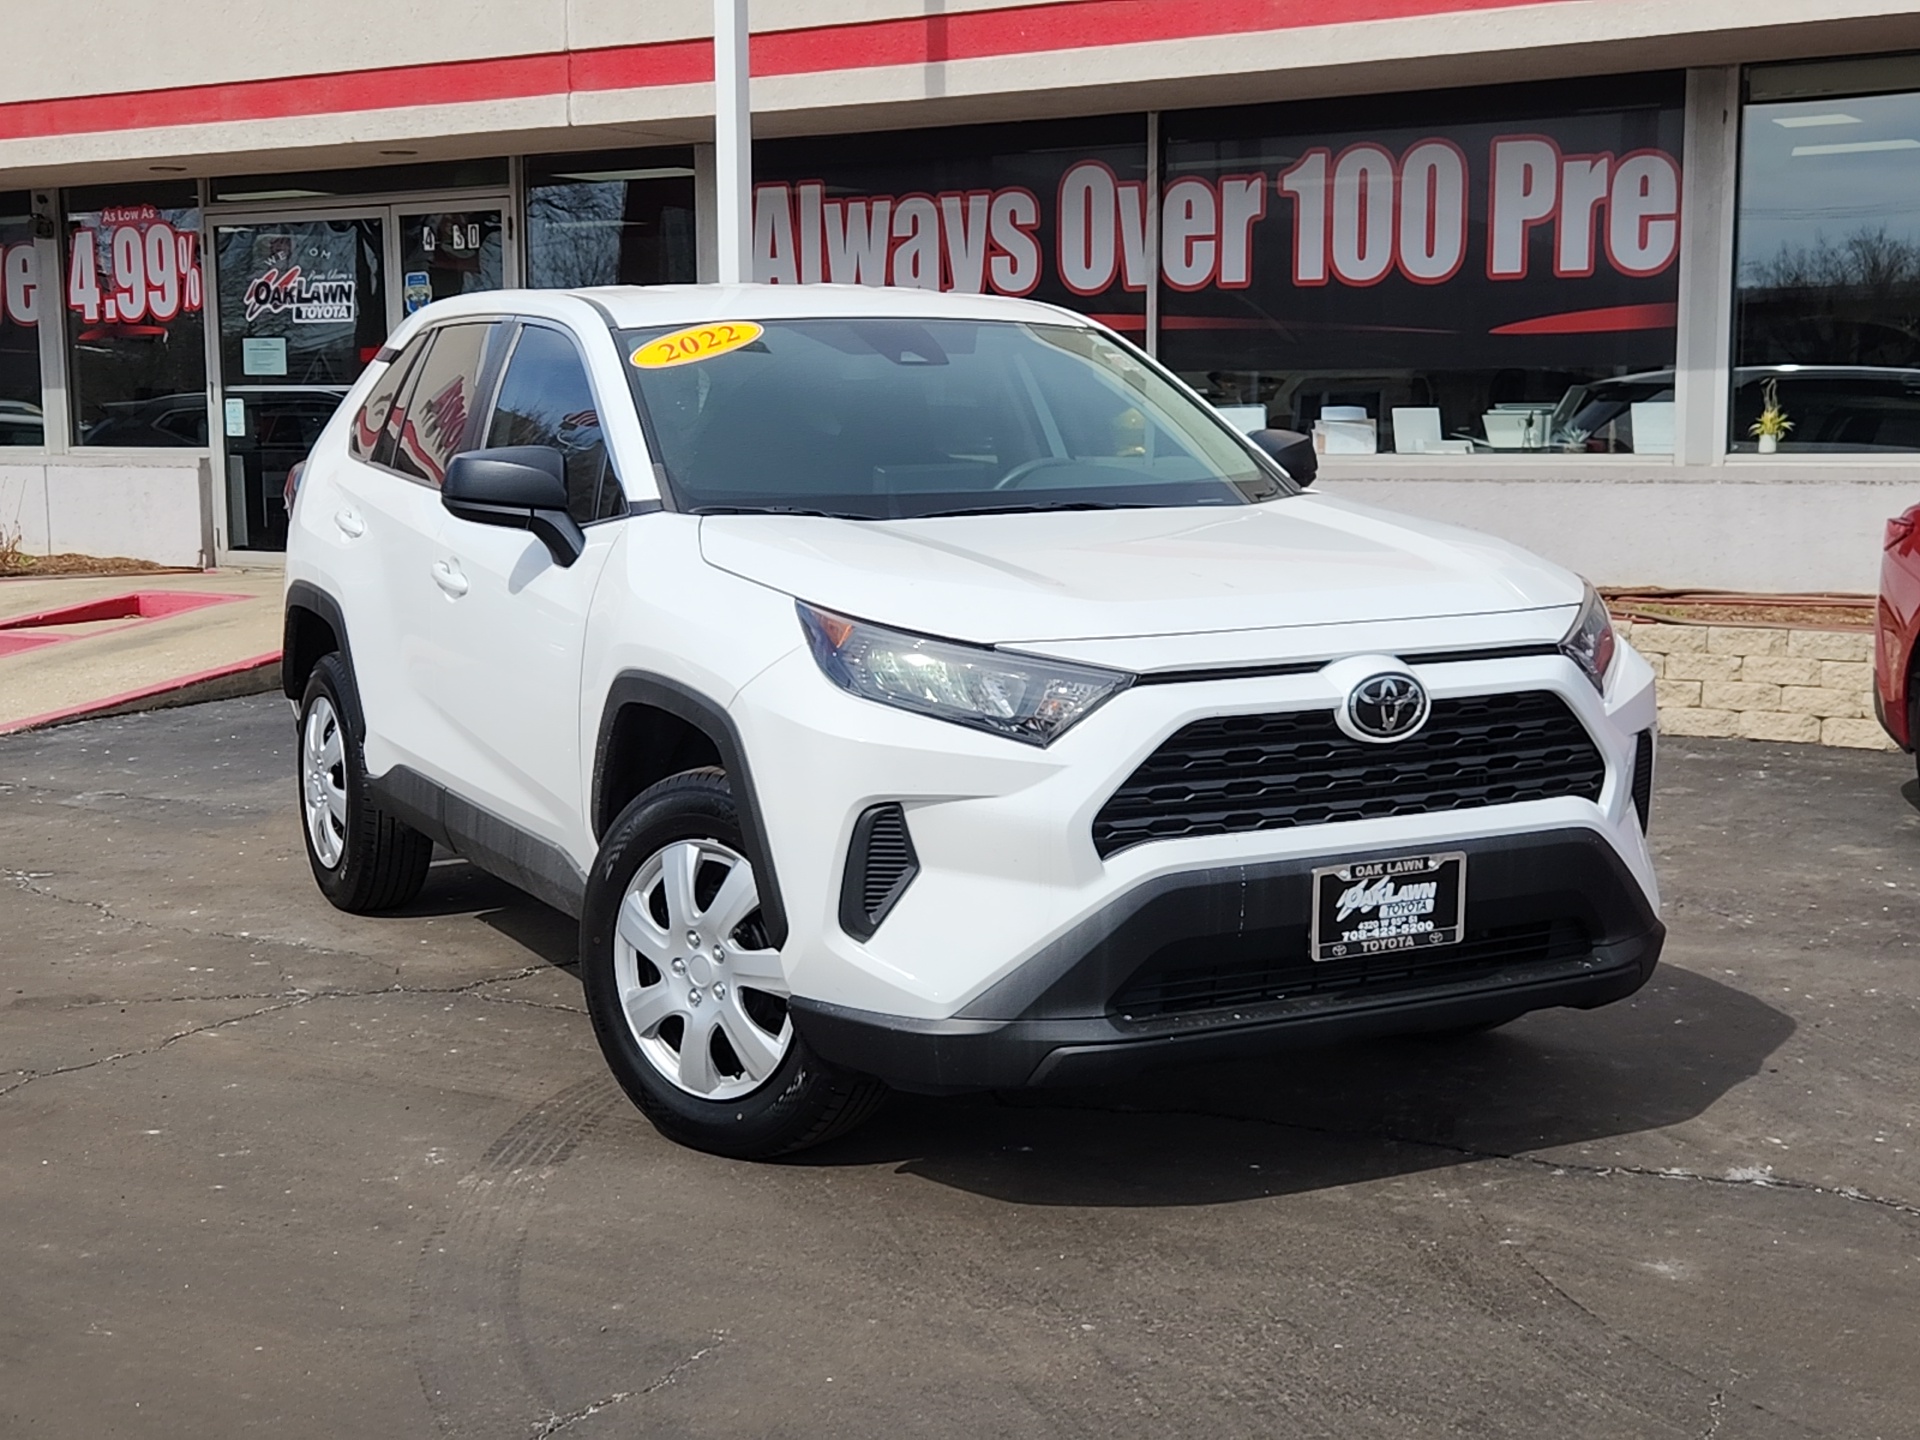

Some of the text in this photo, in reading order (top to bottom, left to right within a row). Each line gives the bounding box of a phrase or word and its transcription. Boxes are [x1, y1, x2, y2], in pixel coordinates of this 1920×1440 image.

[752, 135, 1683, 294] Always Over 100 Pre
[68, 223, 201, 322] 4.99%
[300, 305, 348, 319] TOYOTA
[658, 326, 741, 362] 2022
[1355, 859, 1423, 877] OAK LAWN
[1386, 901, 1428, 916] TOYOTA
[1361, 936, 1415, 952] TOYOTA
